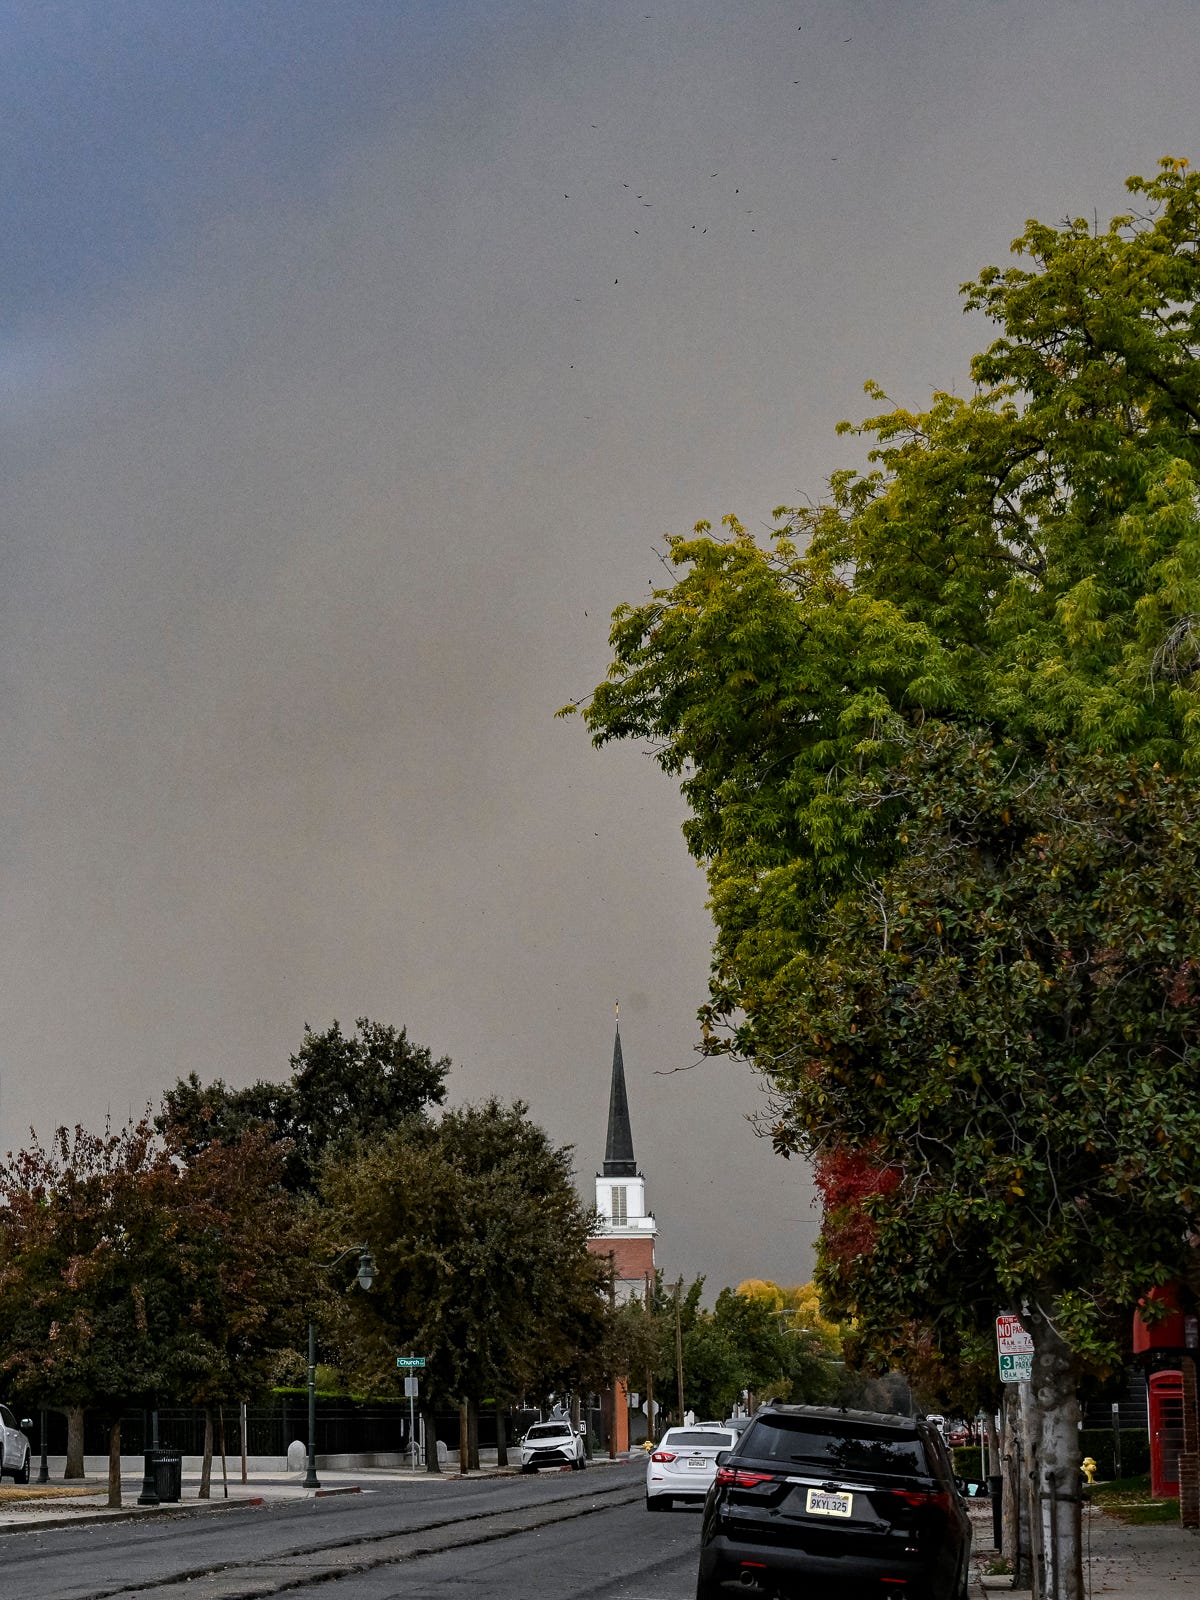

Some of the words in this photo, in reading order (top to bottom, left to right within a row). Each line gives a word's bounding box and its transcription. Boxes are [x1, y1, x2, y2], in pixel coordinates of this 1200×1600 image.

[998, 1323, 1011, 1337] NO
[1013, 1325, 1025, 1333] PAR
[1003, 1356, 1012, 1369] 3
[1015, 1361, 1032, 1369] PARK
[810, 1499, 847, 1513] 9KYL325
